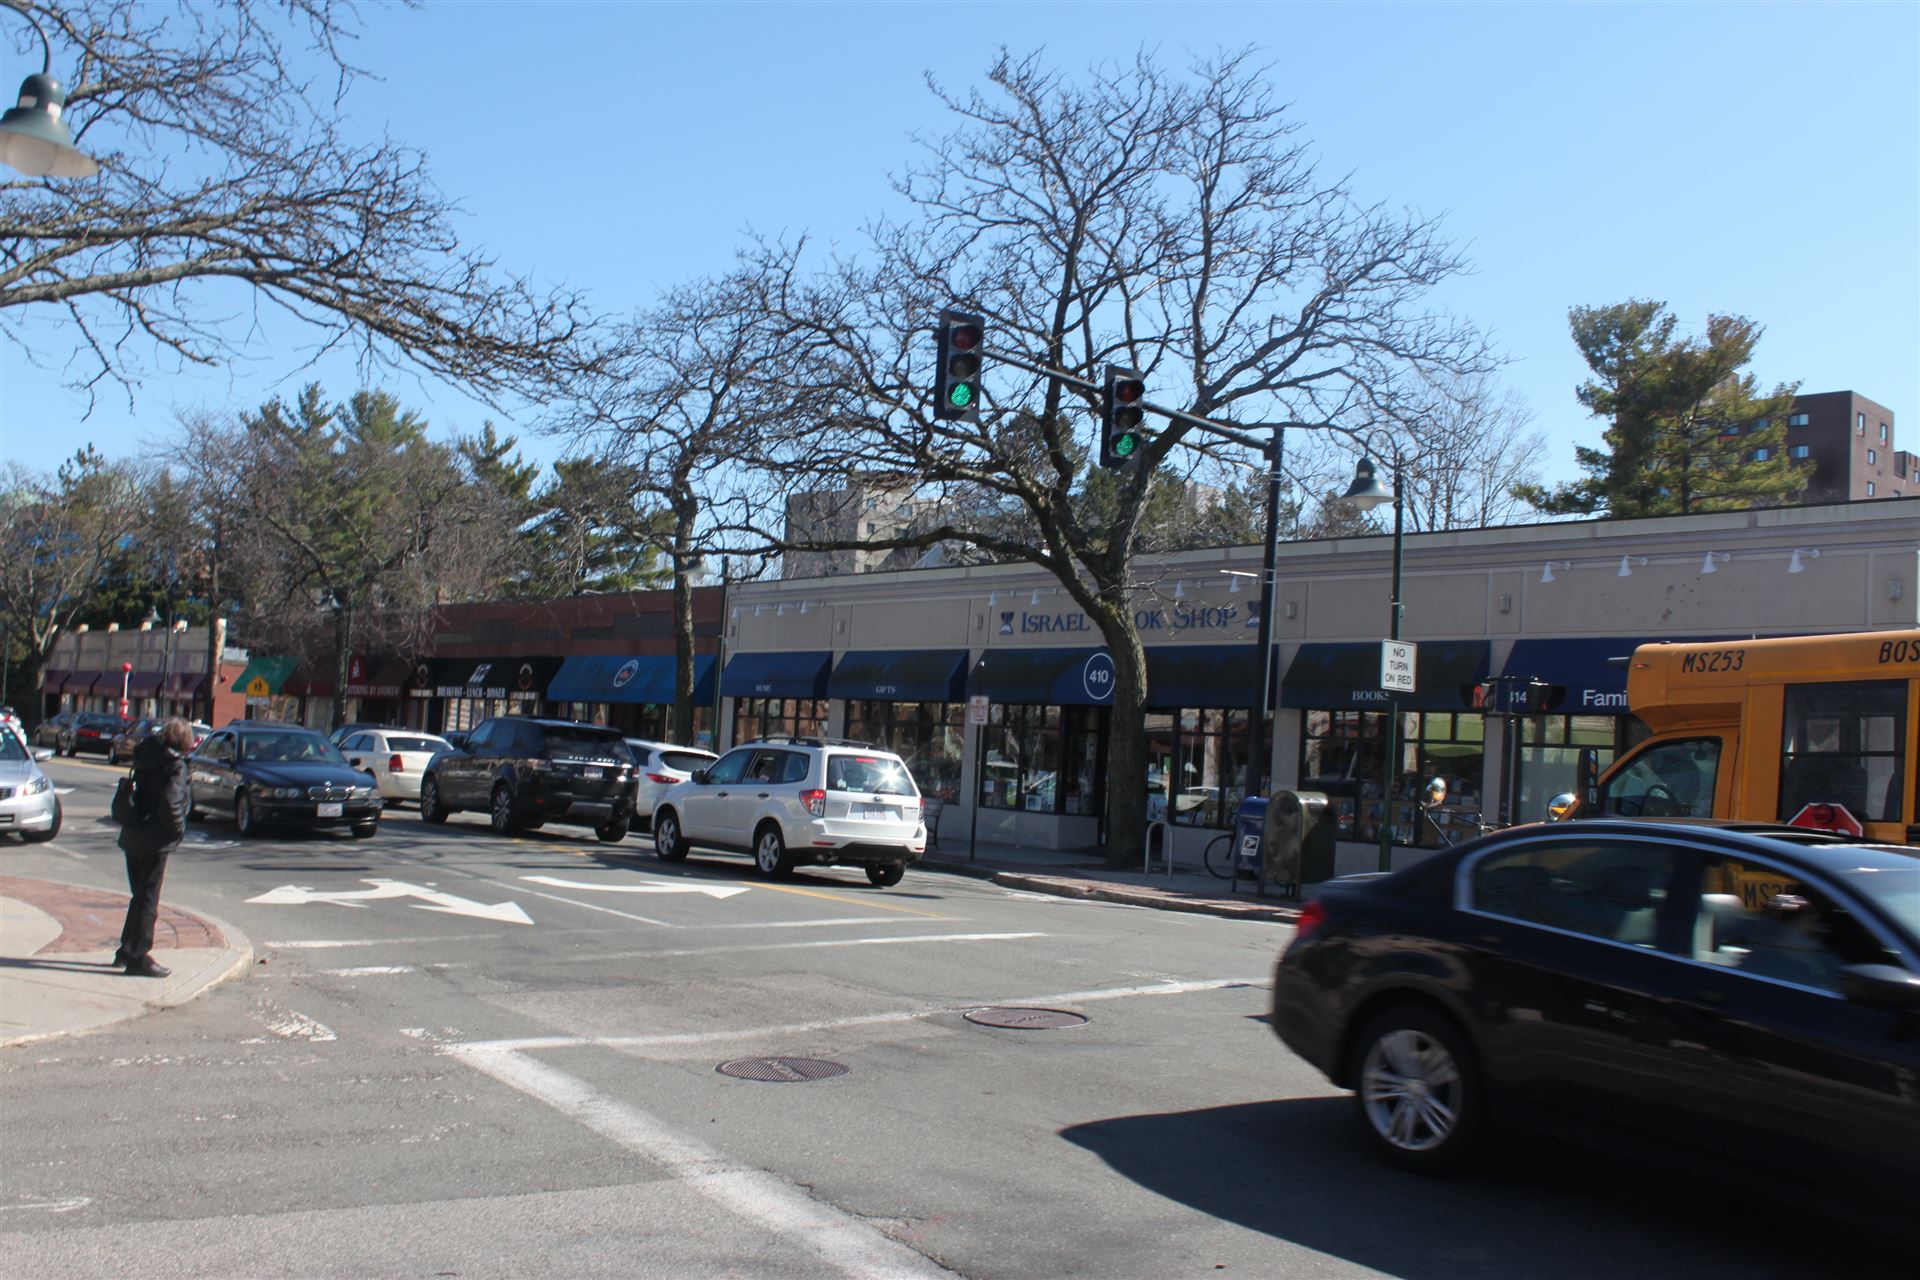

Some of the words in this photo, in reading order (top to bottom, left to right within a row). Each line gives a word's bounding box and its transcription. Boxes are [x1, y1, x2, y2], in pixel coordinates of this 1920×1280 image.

[1021, 612, 1090, 633] ISRAEL
[1135, 609, 1163, 630] OK
[1173, 607, 1238, 628] SHOP
[1393, 648, 1405, 658] NO
[1389, 661, 1408, 672] TURN
[1682, 650, 1745, 673] MS253
[1089, 669, 1109, 684] 410
[1384, 673, 1395, 683] ON
[1397, 675, 1412, 686] RED
[486, 687, 505, 698] DINNER
[874, 685, 896, 695] GIFTS
